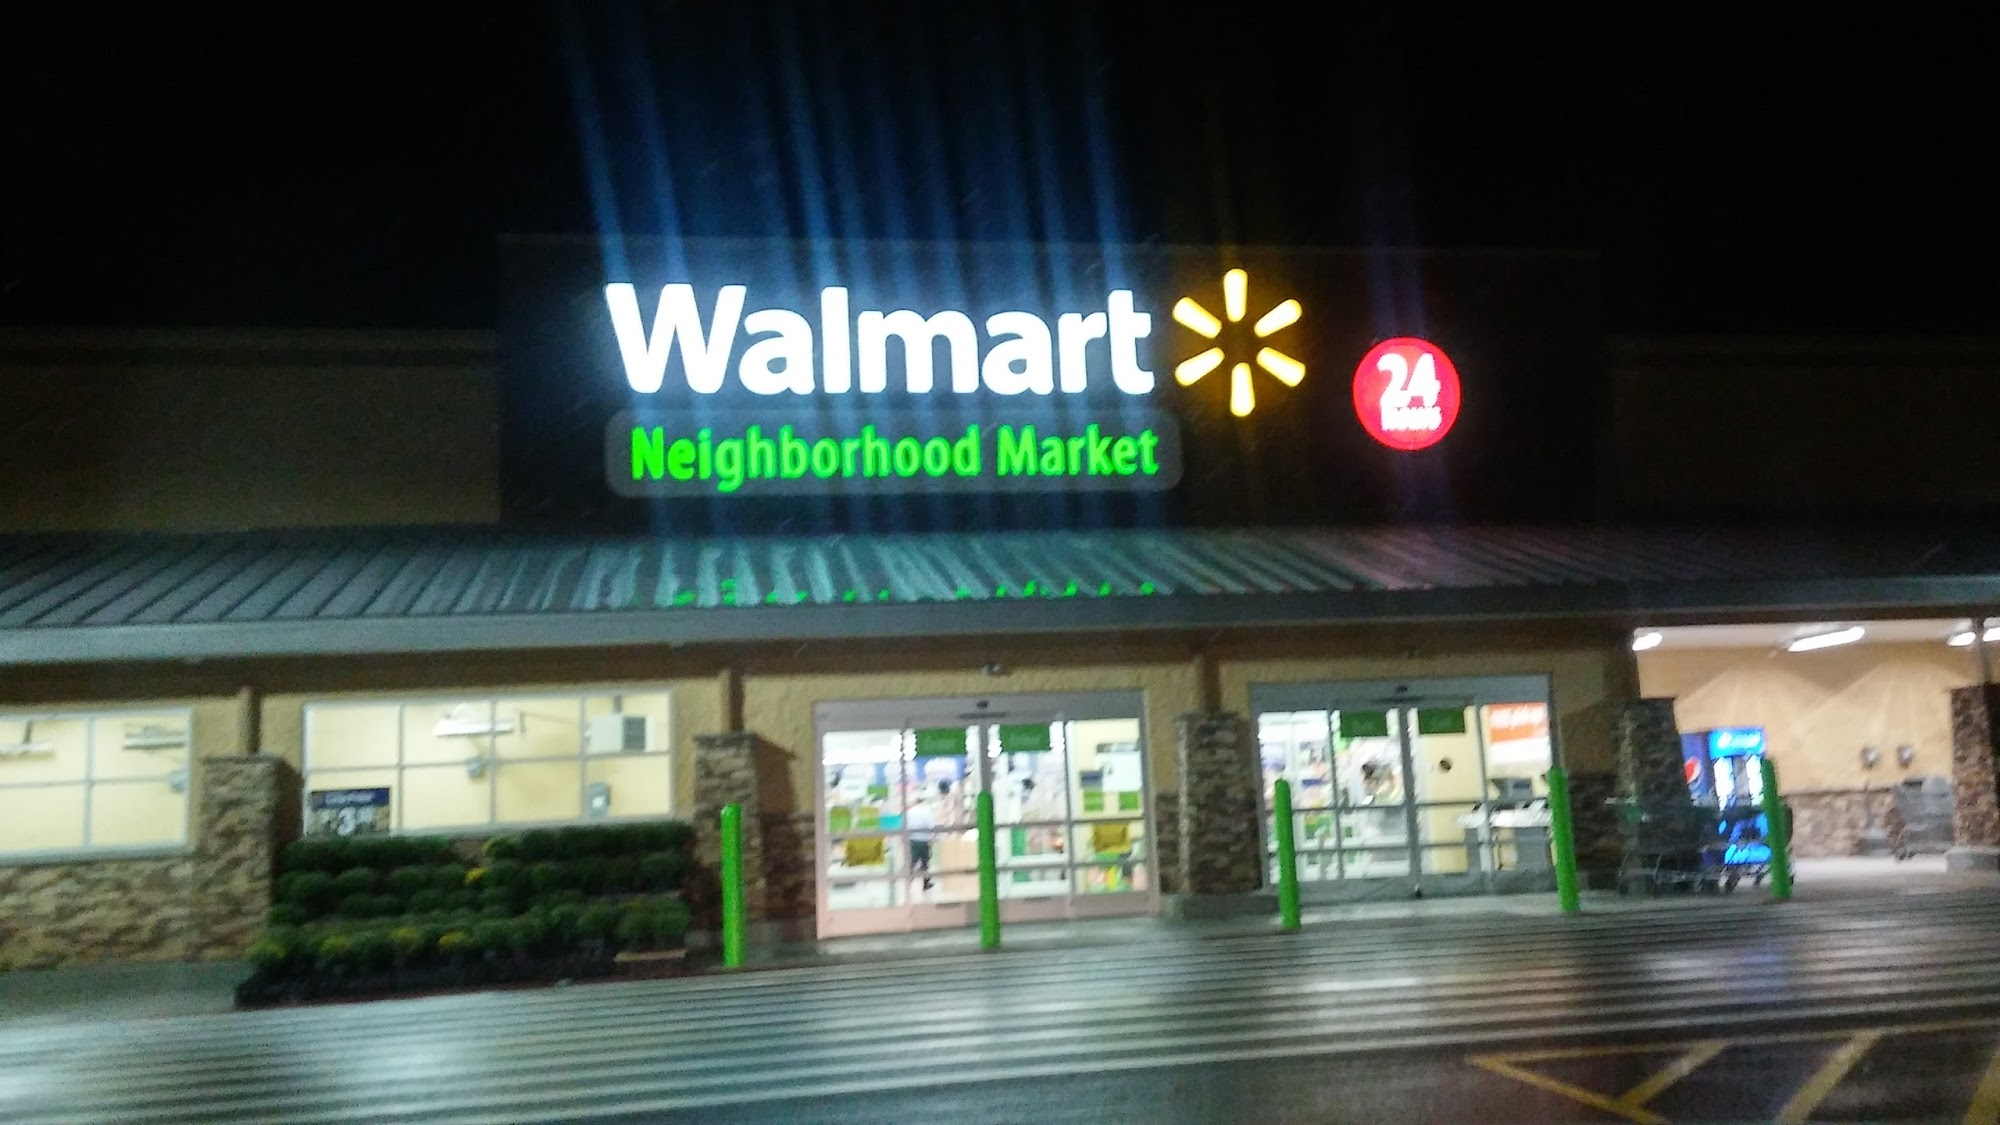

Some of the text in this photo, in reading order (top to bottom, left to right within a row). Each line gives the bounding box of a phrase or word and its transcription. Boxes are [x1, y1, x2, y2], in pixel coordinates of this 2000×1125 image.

[605, 283, 1154, 395] Walmart
[1376, 353, 1441, 407] 24
[631, 424, 1159, 493] Neighborhood Market
